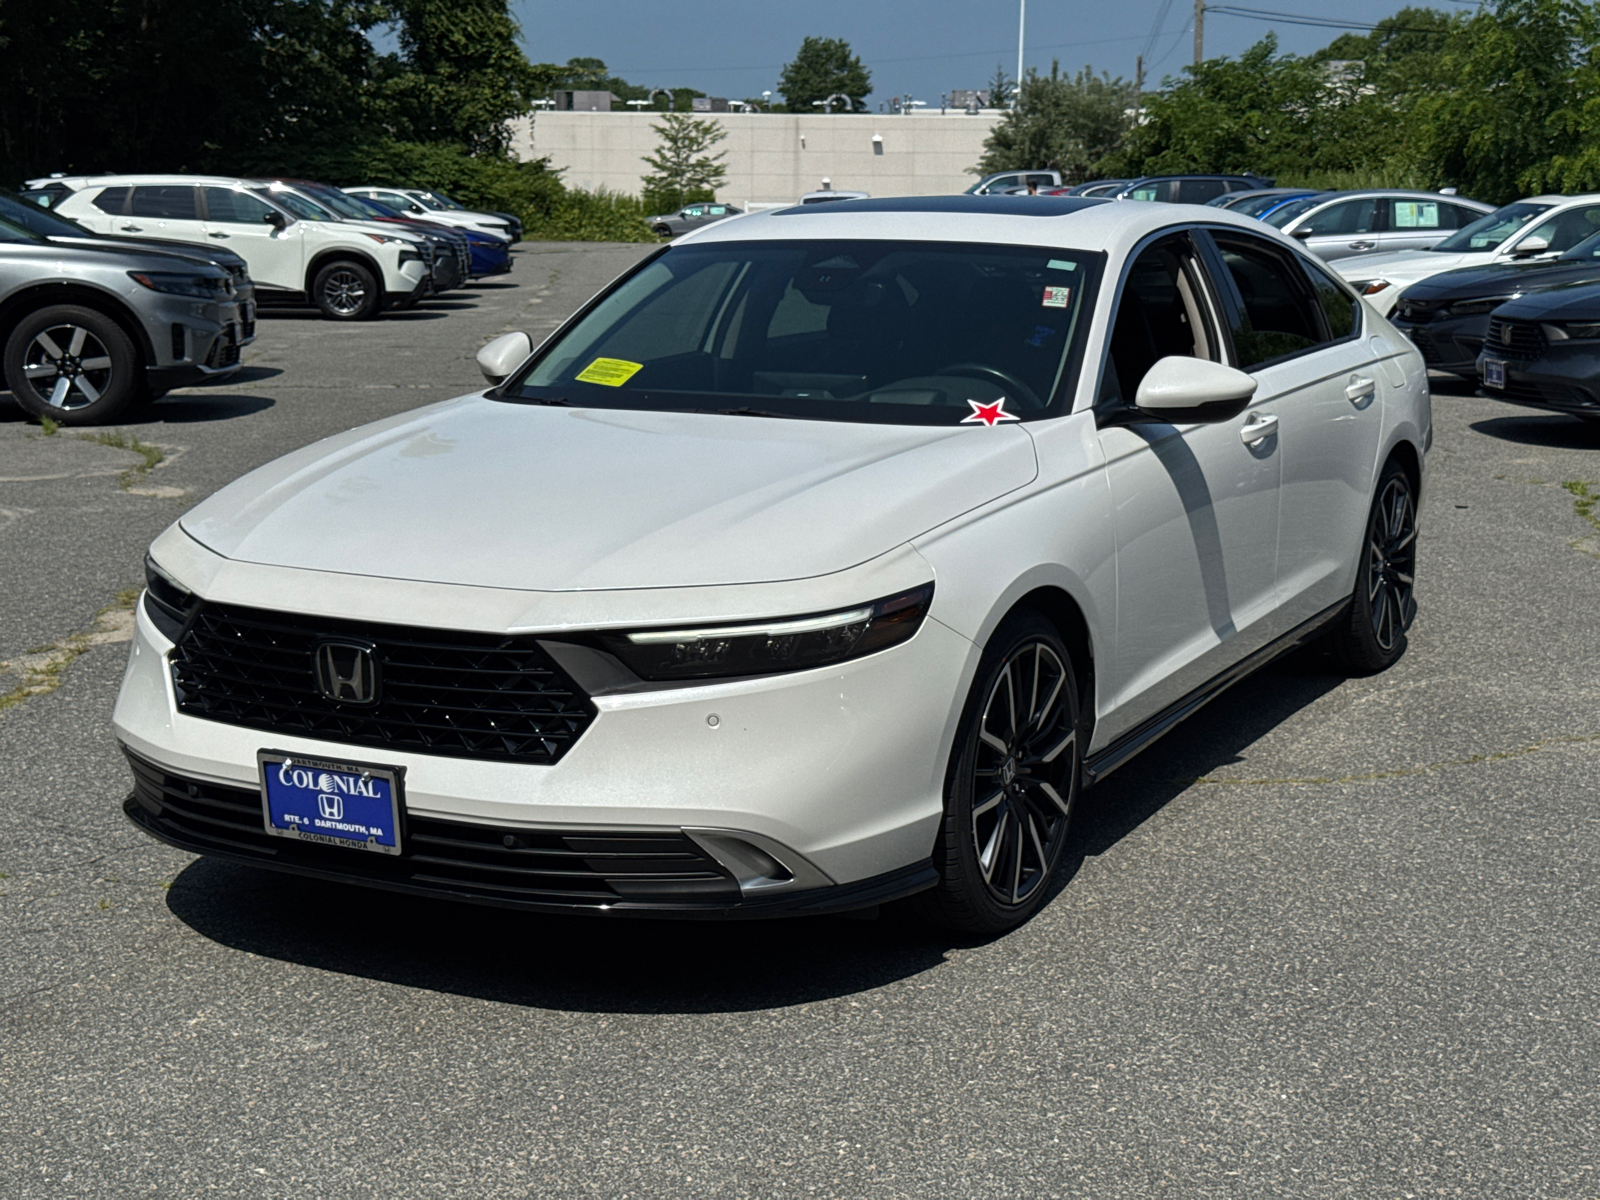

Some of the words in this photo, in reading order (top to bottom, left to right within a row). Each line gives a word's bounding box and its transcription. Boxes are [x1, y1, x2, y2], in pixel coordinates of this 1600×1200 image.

[279, 768, 381, 798] COLONIAL
[284, 814, 302, 824] RTE.
[303, 817, 310, 825] 6
[315, 819, 369, 835] DARTMOUTH,
[370, 827, 383, 836] MA
[298, 832, 338, 845] COLONIAL
[340, 838, 368, 849] HONDA
